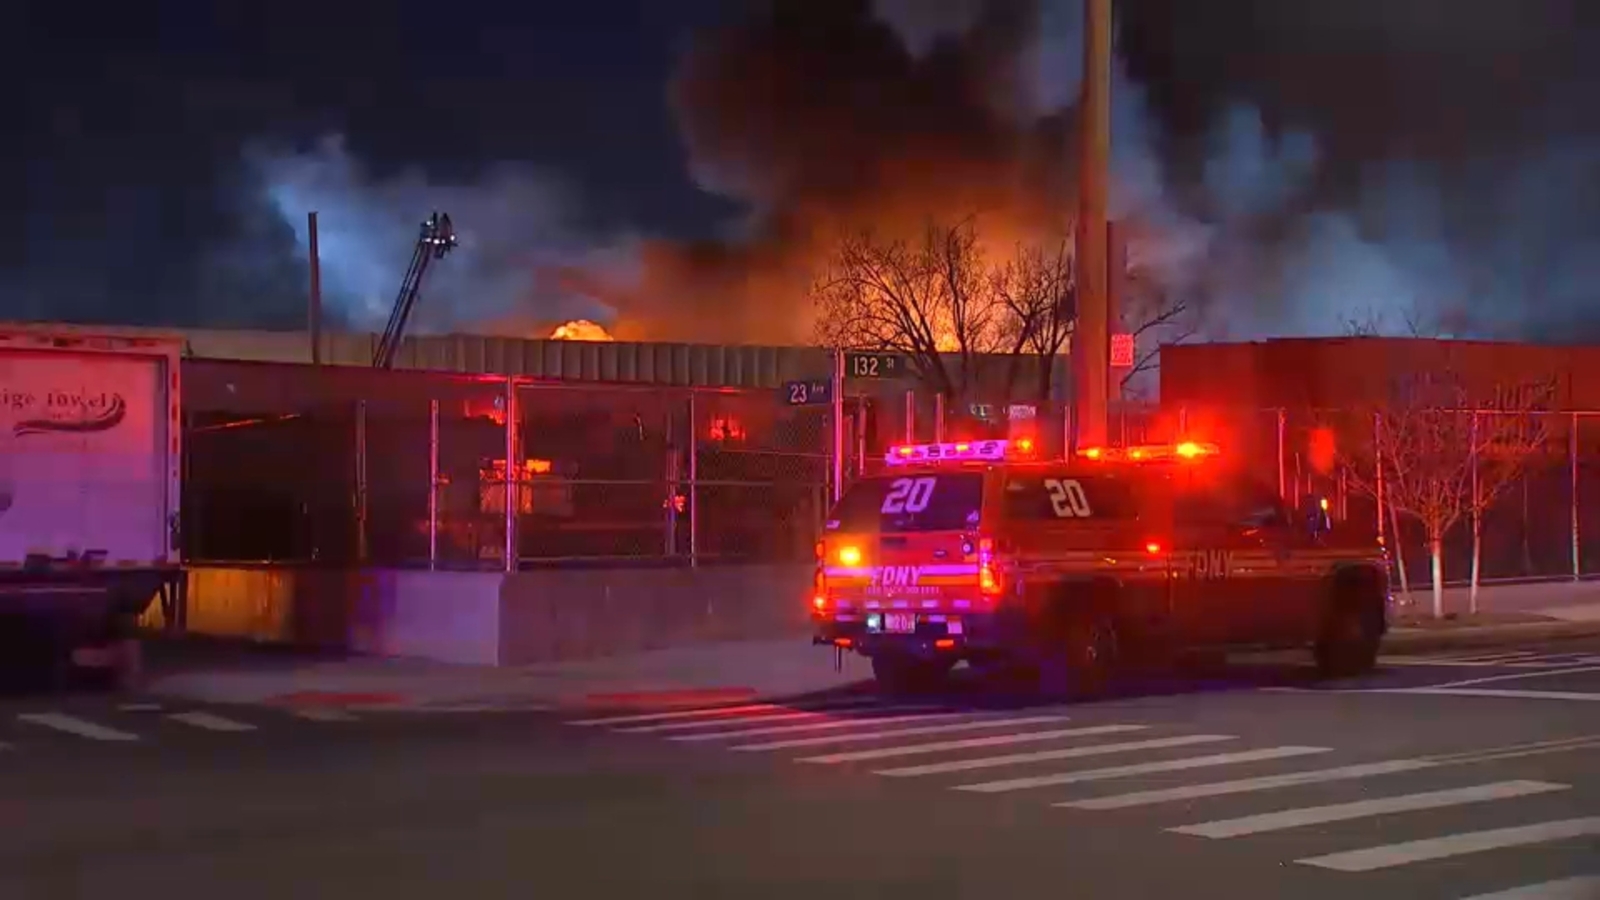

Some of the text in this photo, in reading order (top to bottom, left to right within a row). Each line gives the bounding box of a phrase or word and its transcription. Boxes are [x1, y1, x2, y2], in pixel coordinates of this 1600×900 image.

[854, 356, 878, 376] 132
[790, 384, 807, 403] 23
[881, 477, 936, 514] 20
[1044, 479, 1093, 517] 20
[870, 566, 923, 586] FDNY
